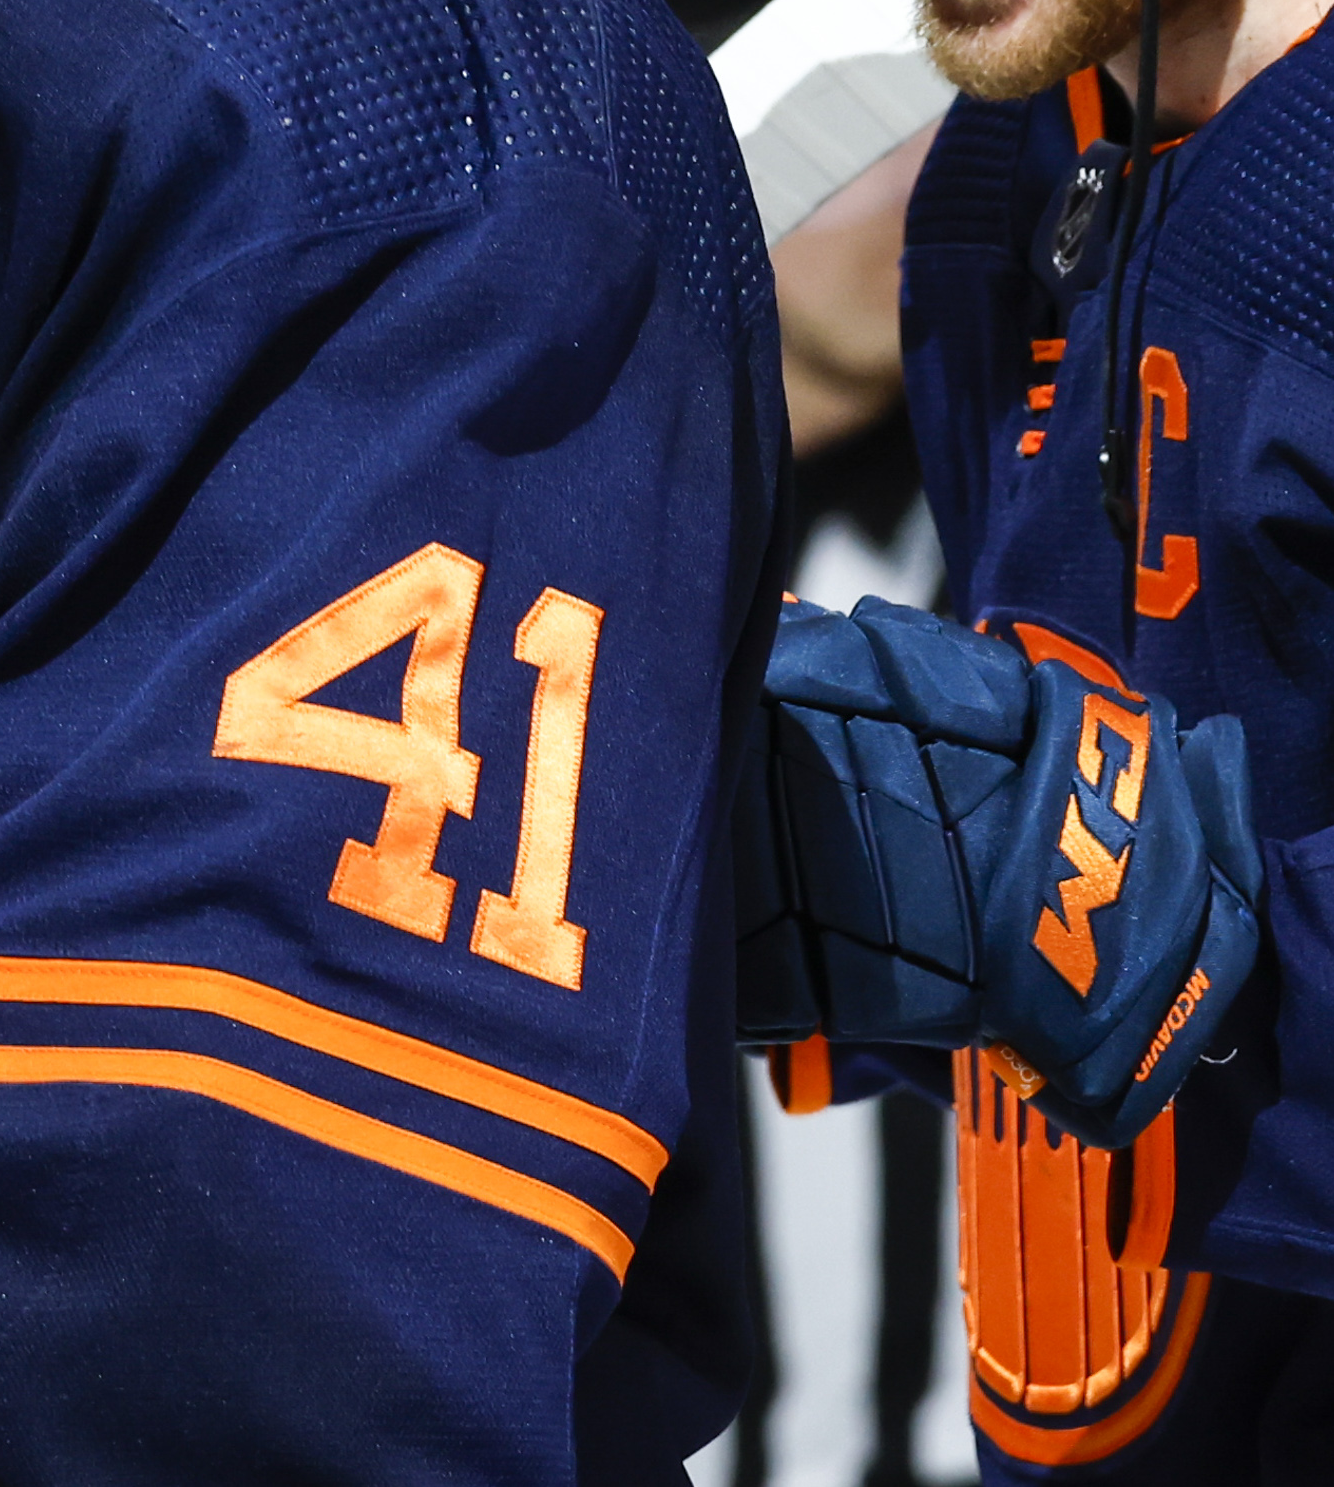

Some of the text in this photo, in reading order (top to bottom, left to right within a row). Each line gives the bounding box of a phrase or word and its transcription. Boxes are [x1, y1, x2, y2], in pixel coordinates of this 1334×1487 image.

[1134, 345, 1200, 620] C
[212, 541, 605, 991] 41
[1033, 691, 1151, 997] CM
